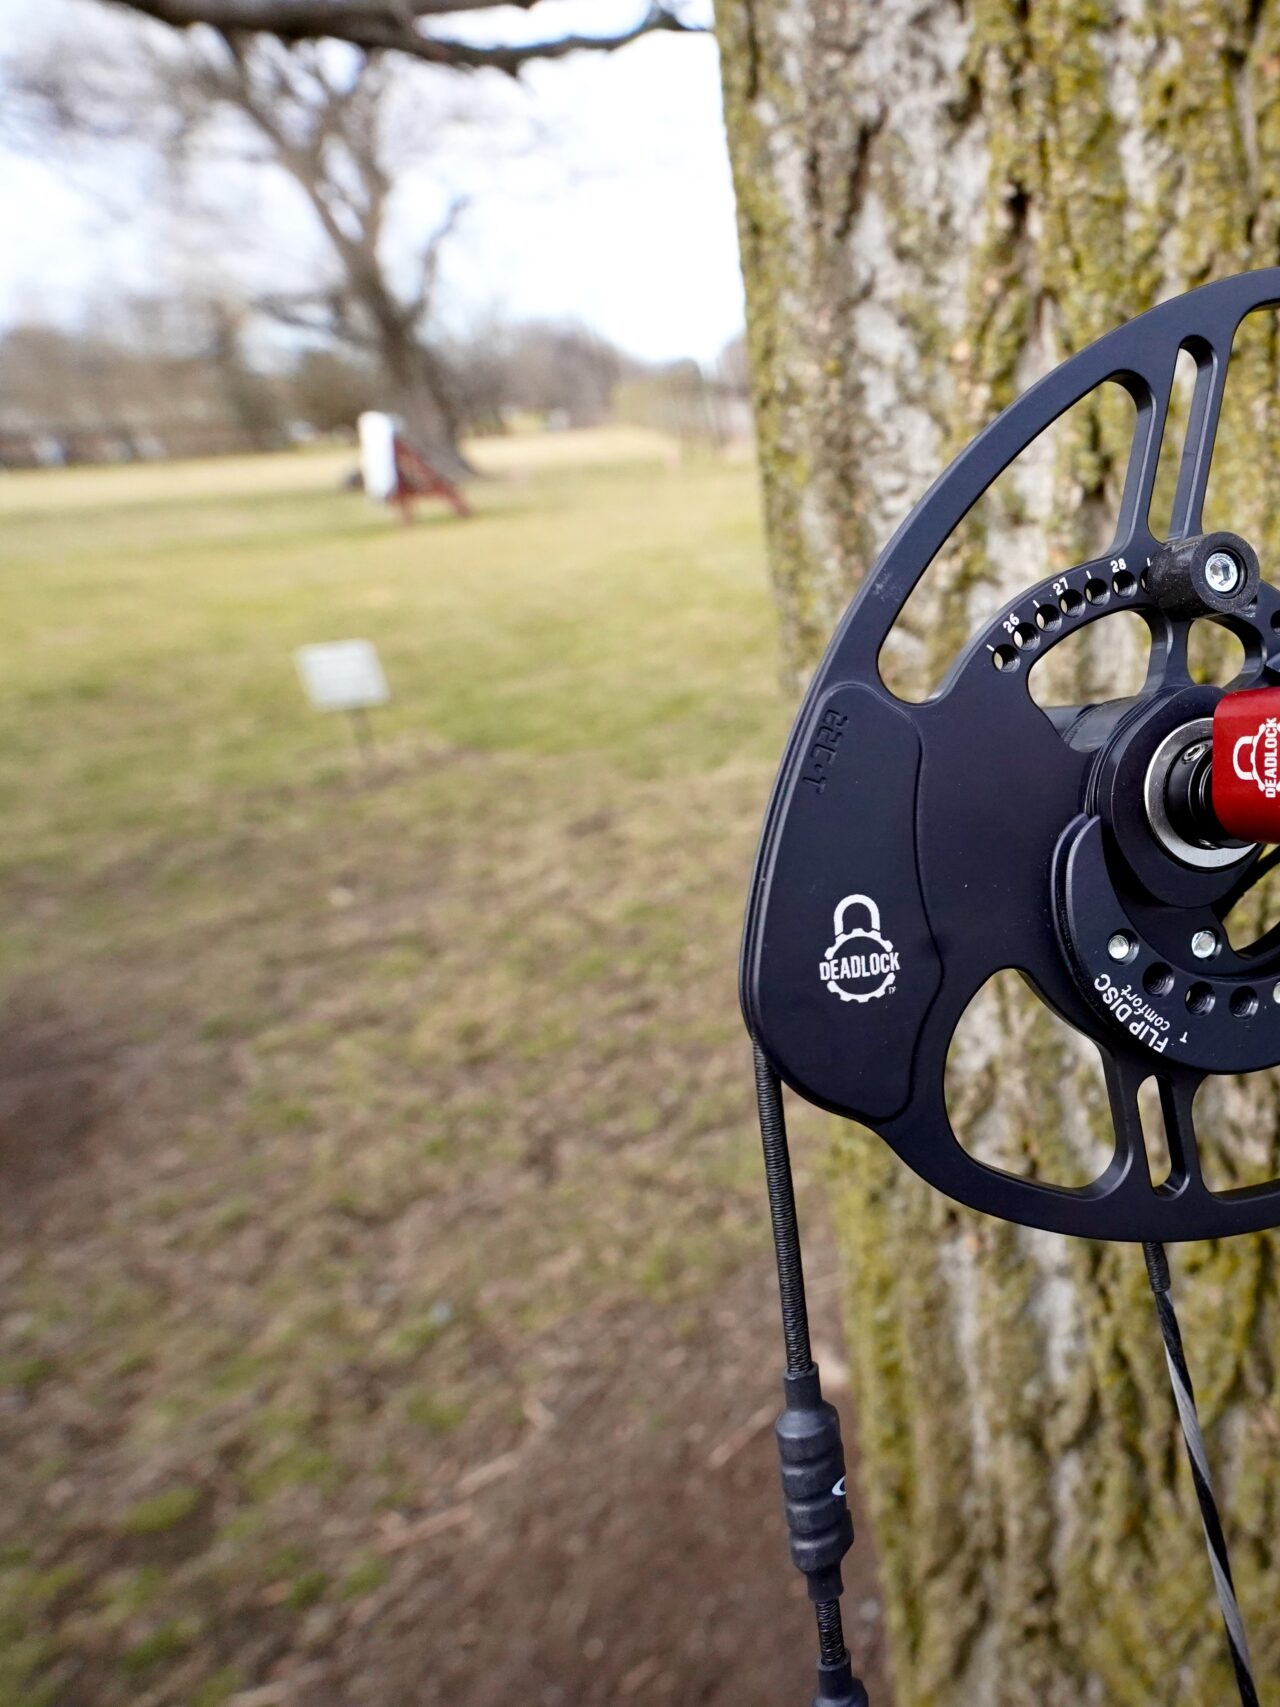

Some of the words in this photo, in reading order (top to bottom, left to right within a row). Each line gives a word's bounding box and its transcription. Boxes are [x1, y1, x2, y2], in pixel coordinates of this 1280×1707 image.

[1110, 557, 1127, 573] 28
[1052, 577, 1069, 596] 27
[1002, 613, 1020, 634] 26
[1264, 717, 1277, 798] DEADLOCK
[819, 952, 900, 981] DEADLOCK
[1094, 973, 1133, 1023] DISC
[1121, 984, 1170, 1031] comfort
[1129, 1021, 1169, 1053] FLIP
